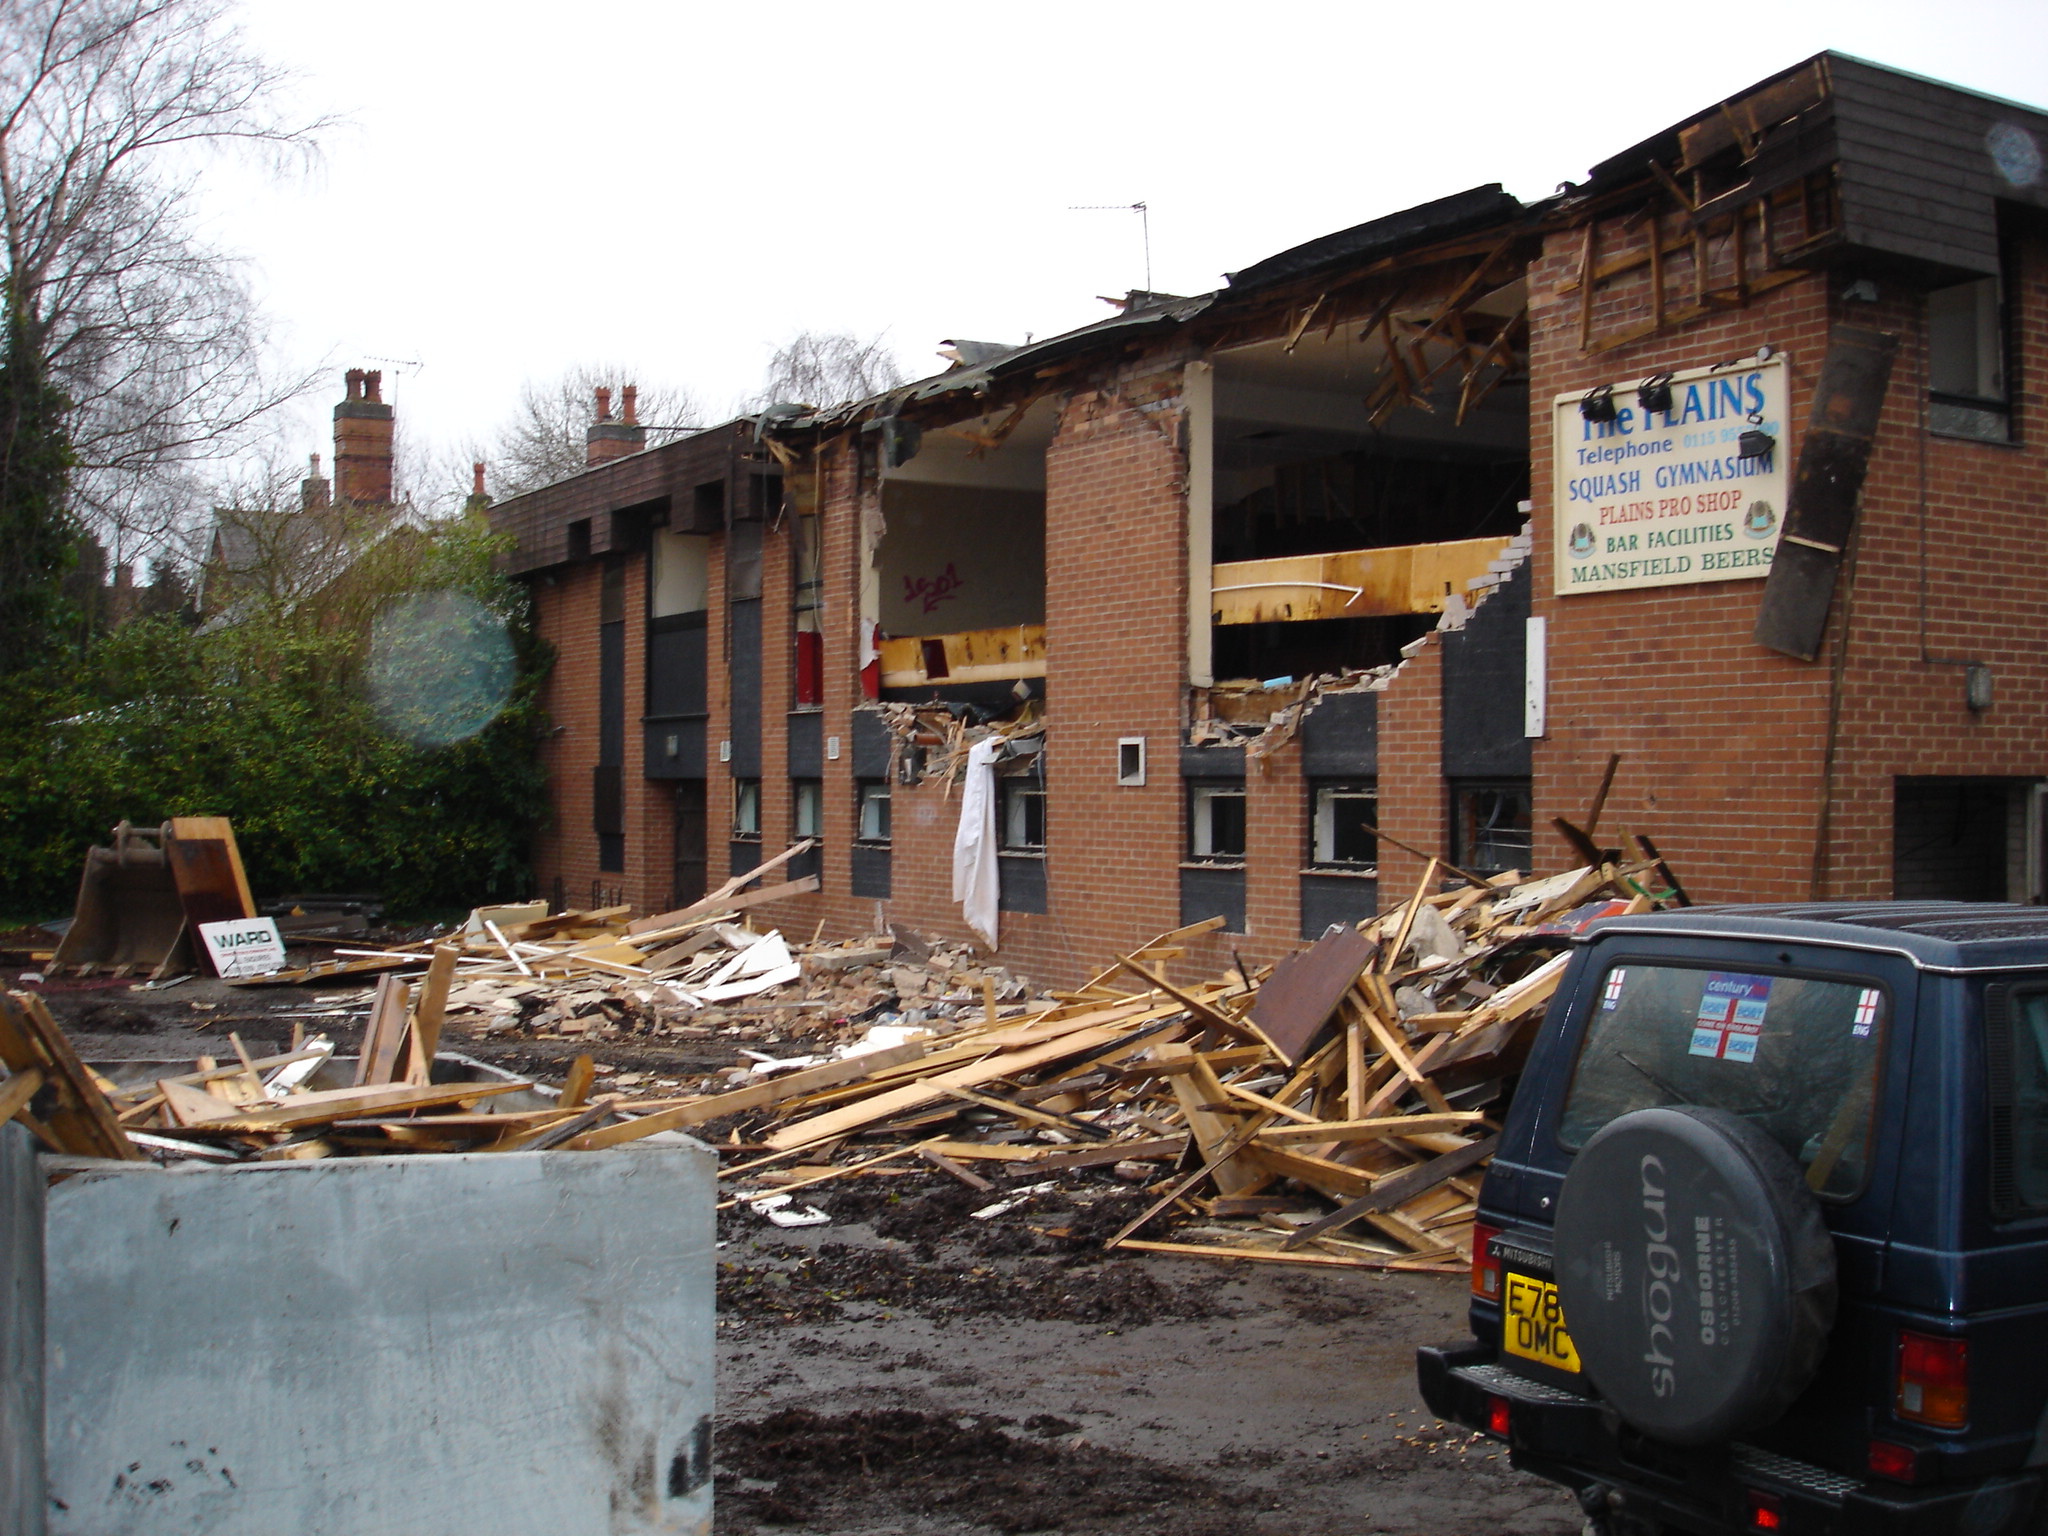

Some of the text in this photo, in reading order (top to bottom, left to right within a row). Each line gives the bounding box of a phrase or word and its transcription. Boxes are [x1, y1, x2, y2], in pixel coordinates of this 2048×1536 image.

[1577, 437, 1673, 466] Telephone
[1683, 430, 1716, 449] 0115
[1568, 451, 1775, 503] SQUASH GYMNASIUM
[1600, 490, 1742, 526] PLAINS PRO SHOP
[1606, 524, 1734, 554] BAR FACILITIES
[1571, 547, 1774, 584] MANSFIELD BEERS
[213, 930, 272, 948] WARD
[1502, 1247, 1552, 1270] MITSUBISHI
[1641, 1154, 1682, 1398] shogun
[1694, 1216, 1716, 1346] OSBORNE
[1716, 1218, 1729, 1346] COLCHESTER
[1509, 1280, 1560, 1323] E78
[1518, 1317, 1568, 1359] OMC
